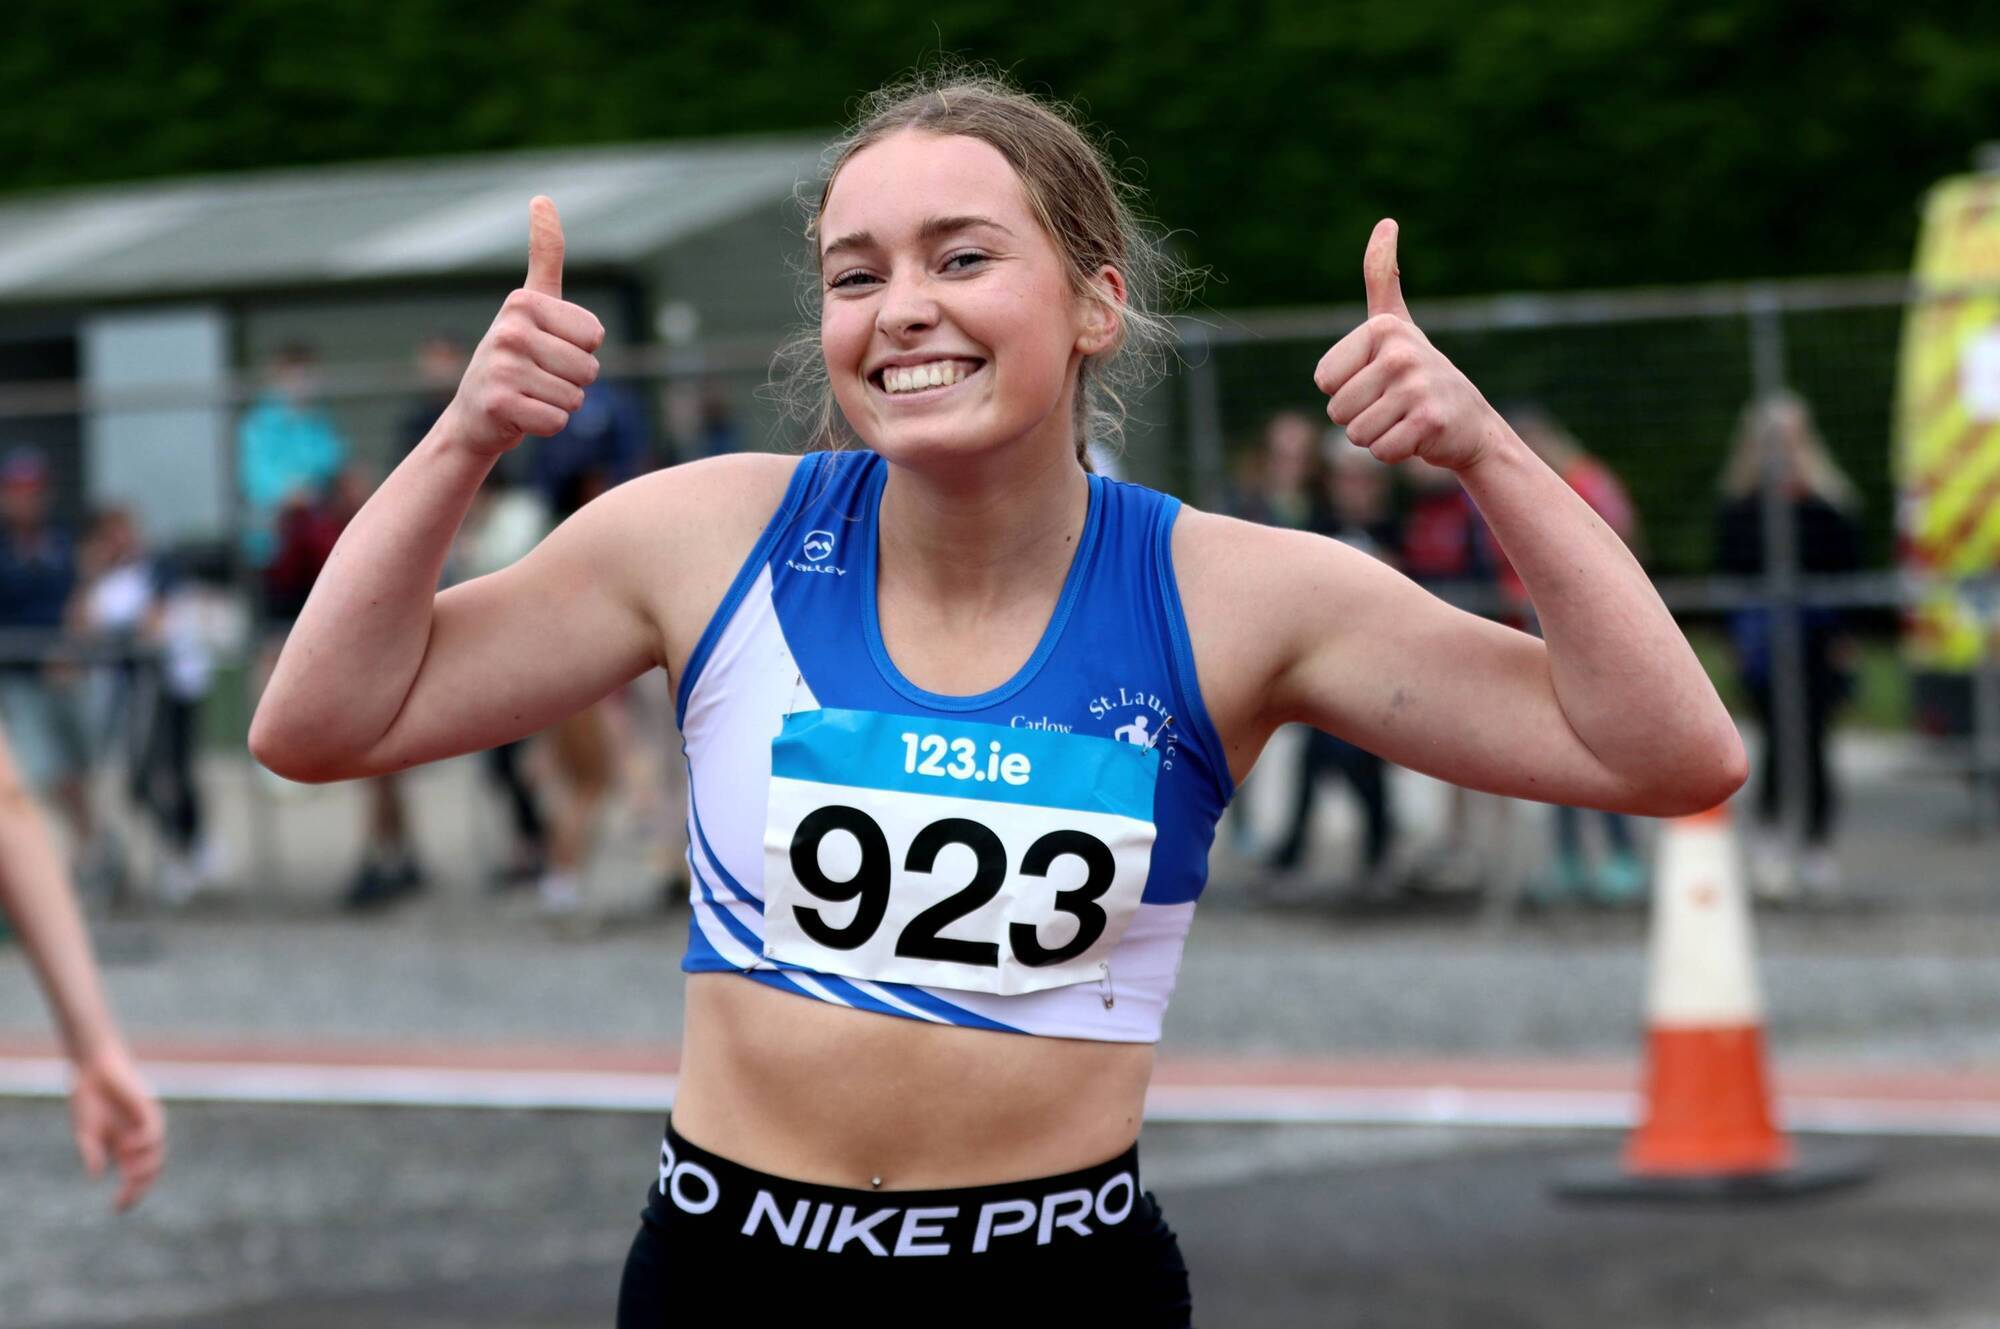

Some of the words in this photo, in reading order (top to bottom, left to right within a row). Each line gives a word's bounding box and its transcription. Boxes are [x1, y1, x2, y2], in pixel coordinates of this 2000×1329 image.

[1010, 715, 1072, 735] Carlow
[1089, 695, 1118, 720] St.
[901, 732, 1031, 785] 123.ie
[789, 804, 1116, 968] 923
[740, 1190, 960, 1257] NIKE
[972, 1171, 1134, 1254] PRO
